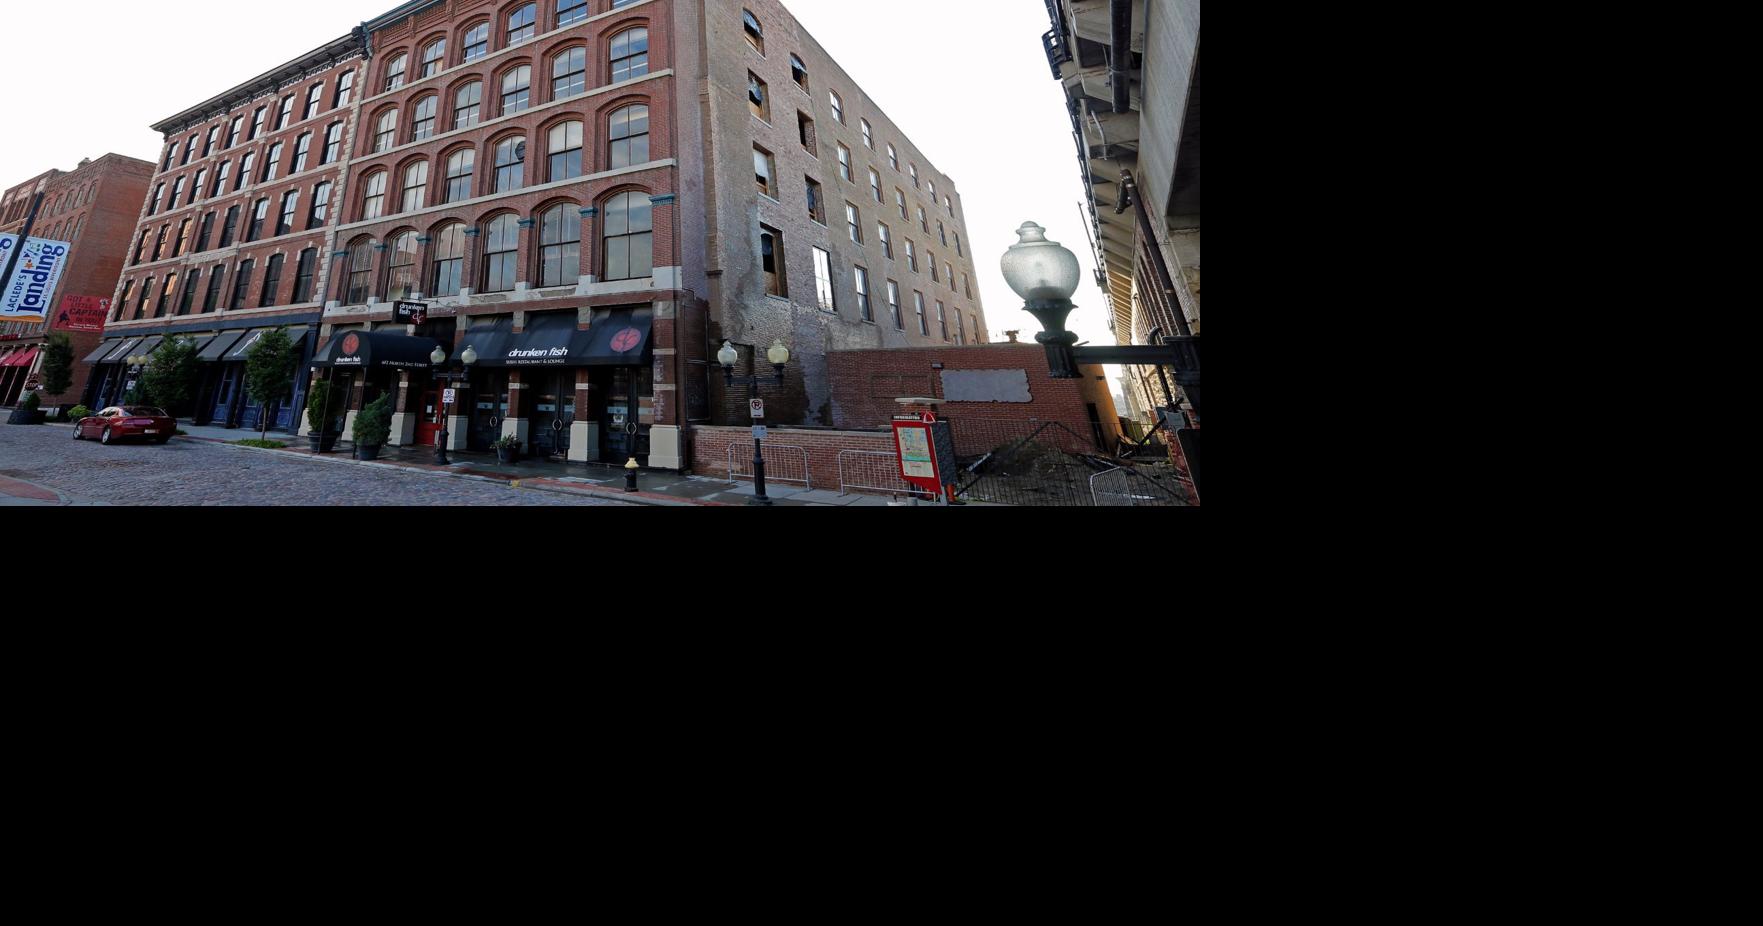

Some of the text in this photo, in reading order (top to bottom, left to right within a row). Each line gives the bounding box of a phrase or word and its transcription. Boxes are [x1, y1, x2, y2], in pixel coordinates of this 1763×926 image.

[16, 243, 65, 314] Landing
[5, 274, 27, 312] LACLEDE'S
[400, 303, 425, 311] drunken
[508, 347, 568, 357] drunken fish
